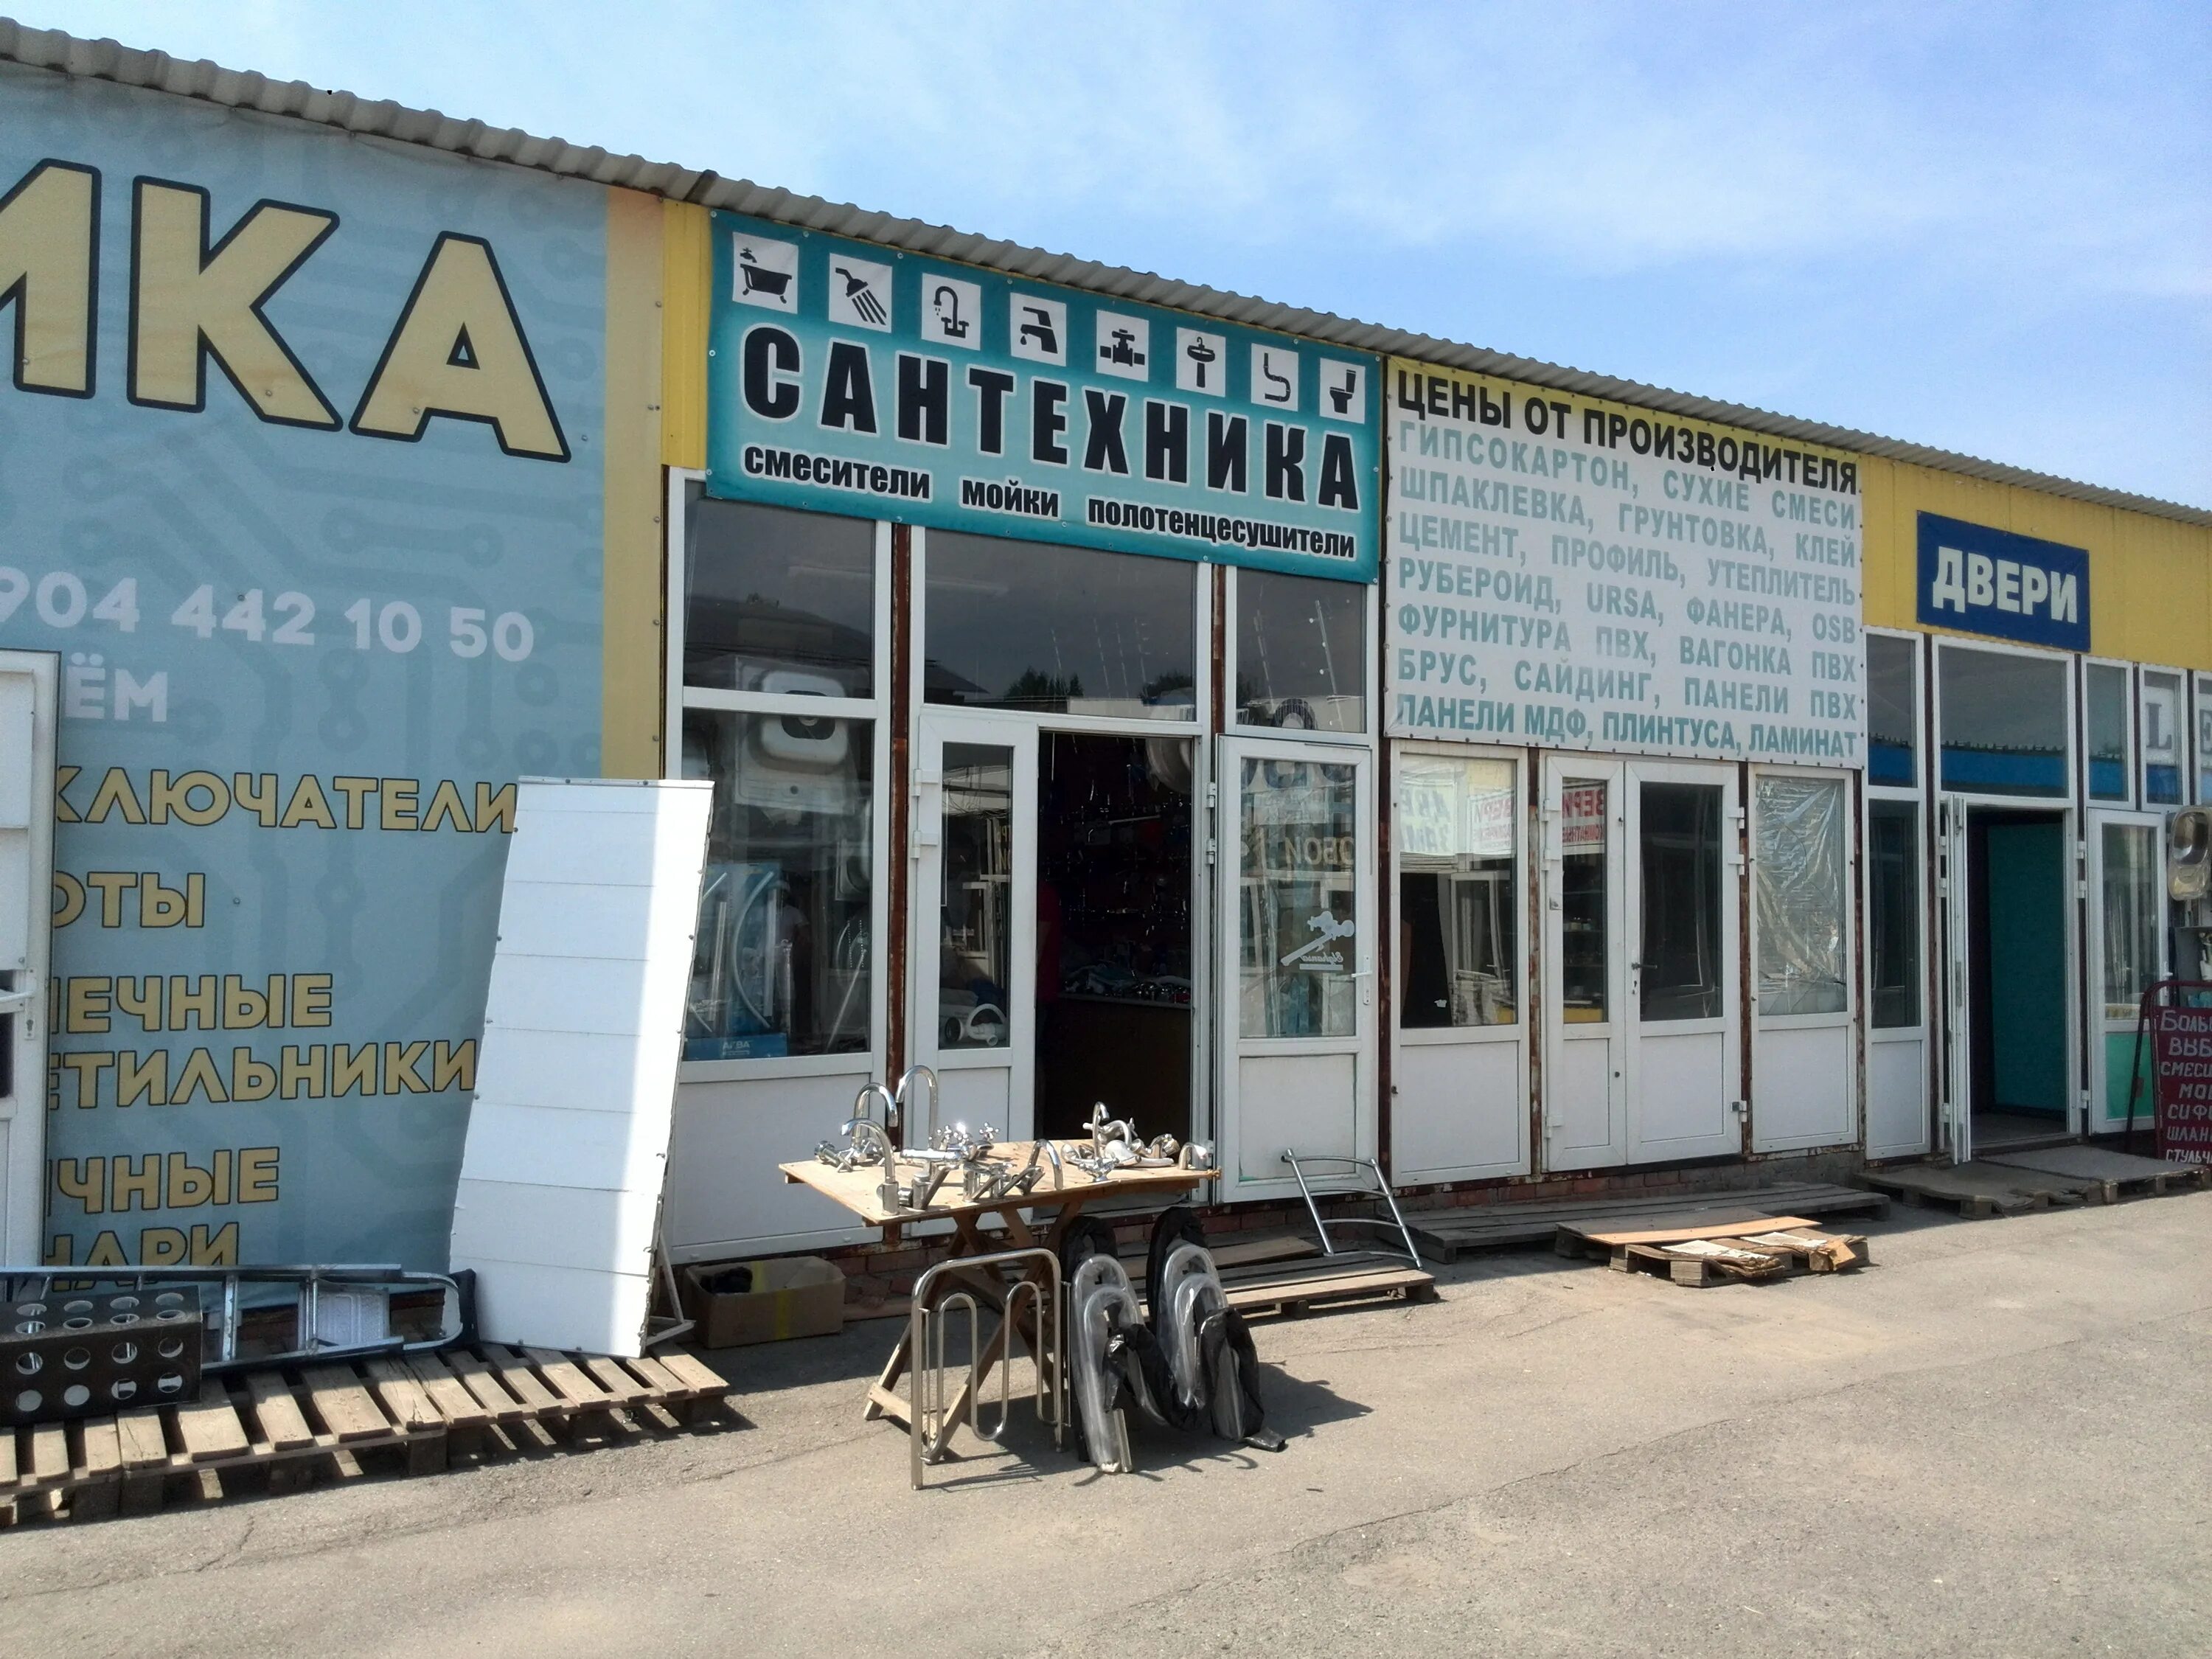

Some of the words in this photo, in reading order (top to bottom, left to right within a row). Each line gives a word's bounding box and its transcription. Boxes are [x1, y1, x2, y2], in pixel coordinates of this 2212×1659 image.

[744, 326, 1359, 511] САНТЕХНИКА
[1398, 369, 1511, 429] ЦЕНЫ
[1524, 397, 1571, 439] ОТ
[1584, 408, 1857, 495] ПРОИЗВОДИТЕЛЯ
[744, 445, 931, 500] смесители
[961, 479, 1060, 518] мойки
[1088, 498, 1355, 558] полотенцесушители
[1399, 420, 1638, 499] ГИПСОКАРТОН,
[1663, 469, 1750, 512] СУХИЕ
[1772, 490, 1855, 531] СМЕСИ
[1400, 465, 1594, 535] ШПАКЛЕВКА,
[1618, 502, 1775, 562] ГРУНТОВКА,
[1795, 532, 1856, 568] КЛЕЙ
[1399, 511, 1526, 568] ЦЕМЕНТ,
[1551, 534, 1686, 589] ПРОФИЛЬ,
[1707, 557, 1856, 606] УТЕПЛИТЕЛЬ
[1932, 546, 2078, 624] ДВЕРИ
[170, 583, 316, 647] 442
[344, 598, 422, 654] 10
[448, 608, 535, 662] 50
[1399, 557, 1562, 615] РУБЕРОИД,
[1587, 582, 1665, 627] URSA,
[1686, 596, 1792, 643] ФАНЕРА,
[1812, 612, 1856, 644] OSB
[1398, 602, 1572, 653] ФУРНИТУРА
[1596, 625, 1657, 668] ПВХ,
[1679, 635, 1792, 676] ВАГОНКА
[1811, 650, 1857, 683] ПВХ
[1398, 647, 1487, 695] БРУС,
[1514, 657, 1660, 710] САЙДИНГ,
[1684, 676, 1789, 714] ПАНЕЛИ
[1810, 689, 1857, 721] ПВХ
[1397, 693, 1514, 734] ПАНЕЛИ
[1524, 703, 1593, 747] МДФ,
[1602, 711, 1742, 757] ПЛИНТУСА,
[1748, 723, 1857, 758] ЛАМИНАТ
[51, 973, 333, 1034] ЕЧНЫЕ
[2166, 1125, 2212, 1142] ШЛАН
[47, 1146, 280, 1217] ЧНЫЕ
